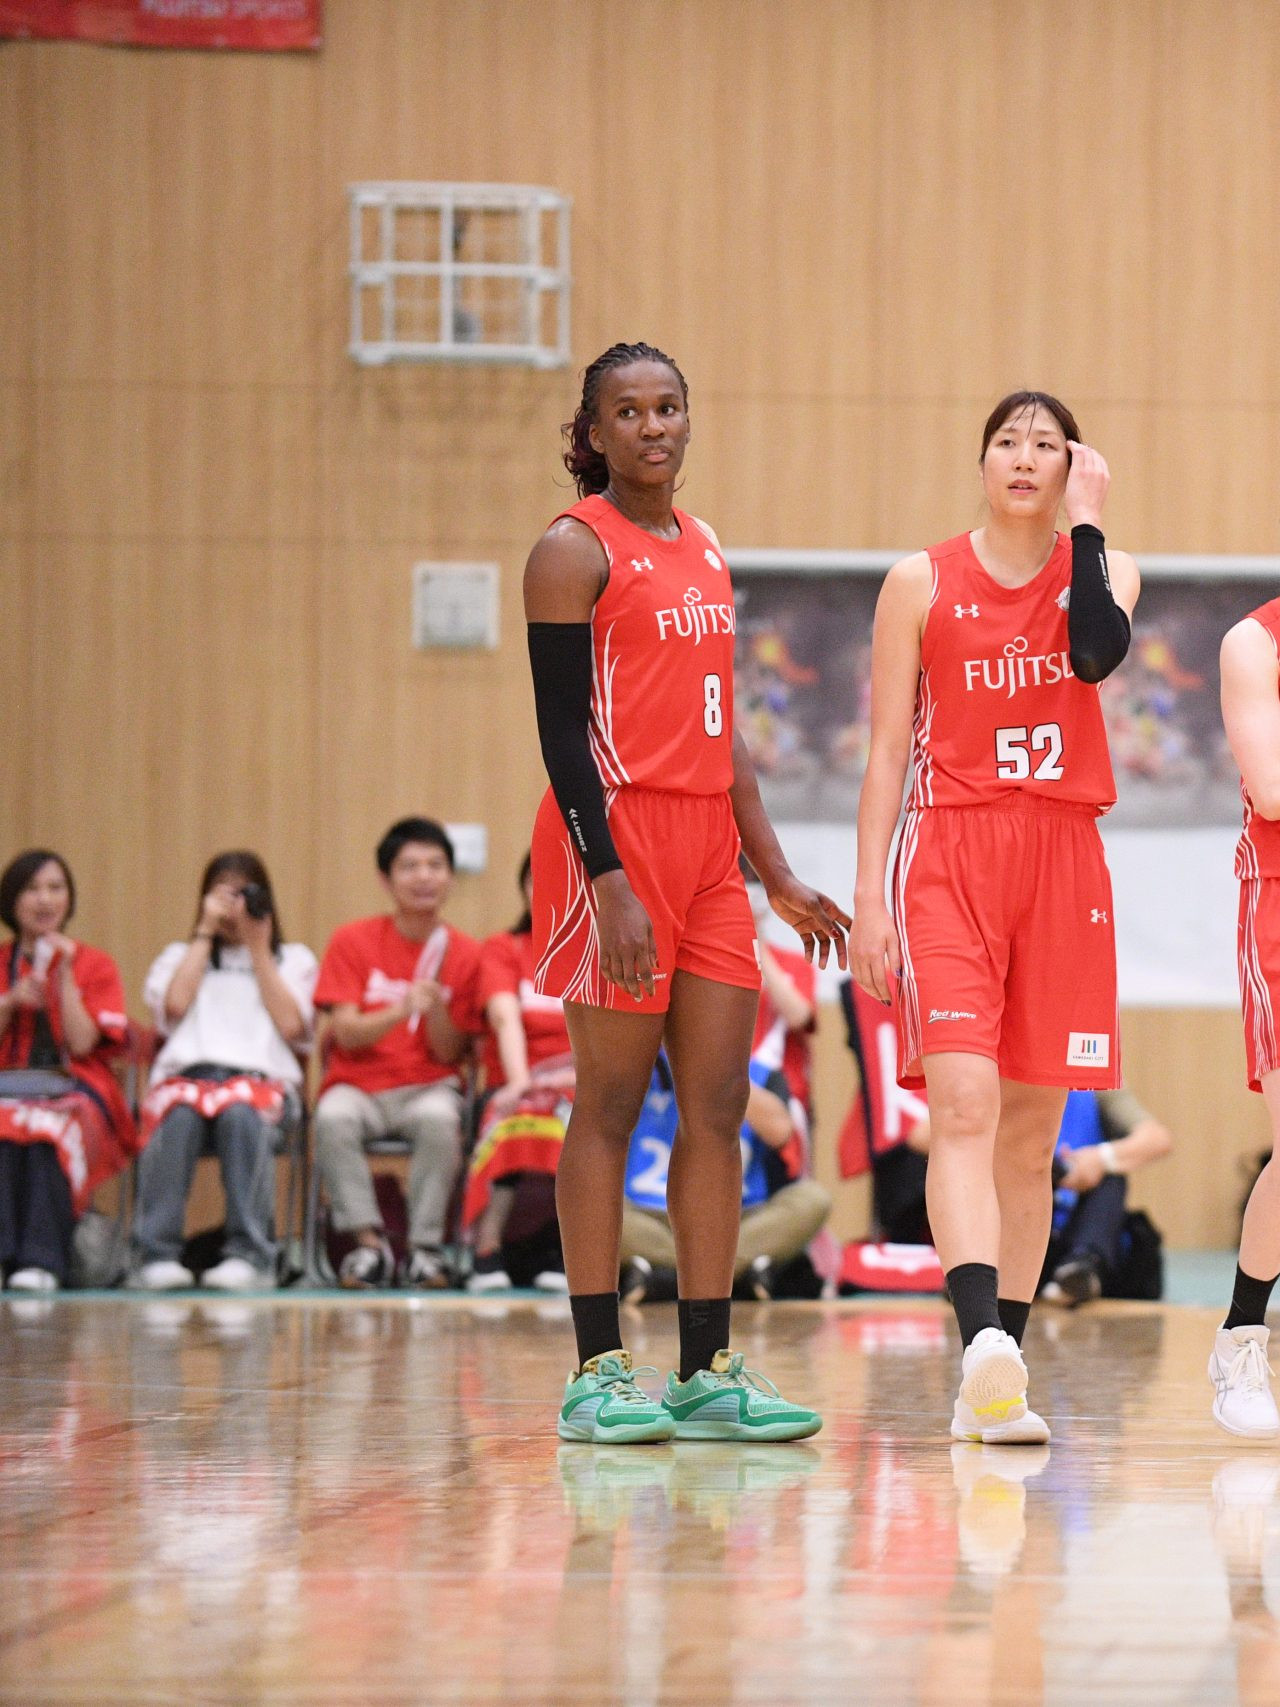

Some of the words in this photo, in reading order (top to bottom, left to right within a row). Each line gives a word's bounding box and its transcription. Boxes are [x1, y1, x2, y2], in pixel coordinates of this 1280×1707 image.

[655, 603, 737, 646] FUJITSU
[703, 672, 723, 738] 8
[994, 722, 1065, 782] 52
[929, 1009, 950, 1019] Red
